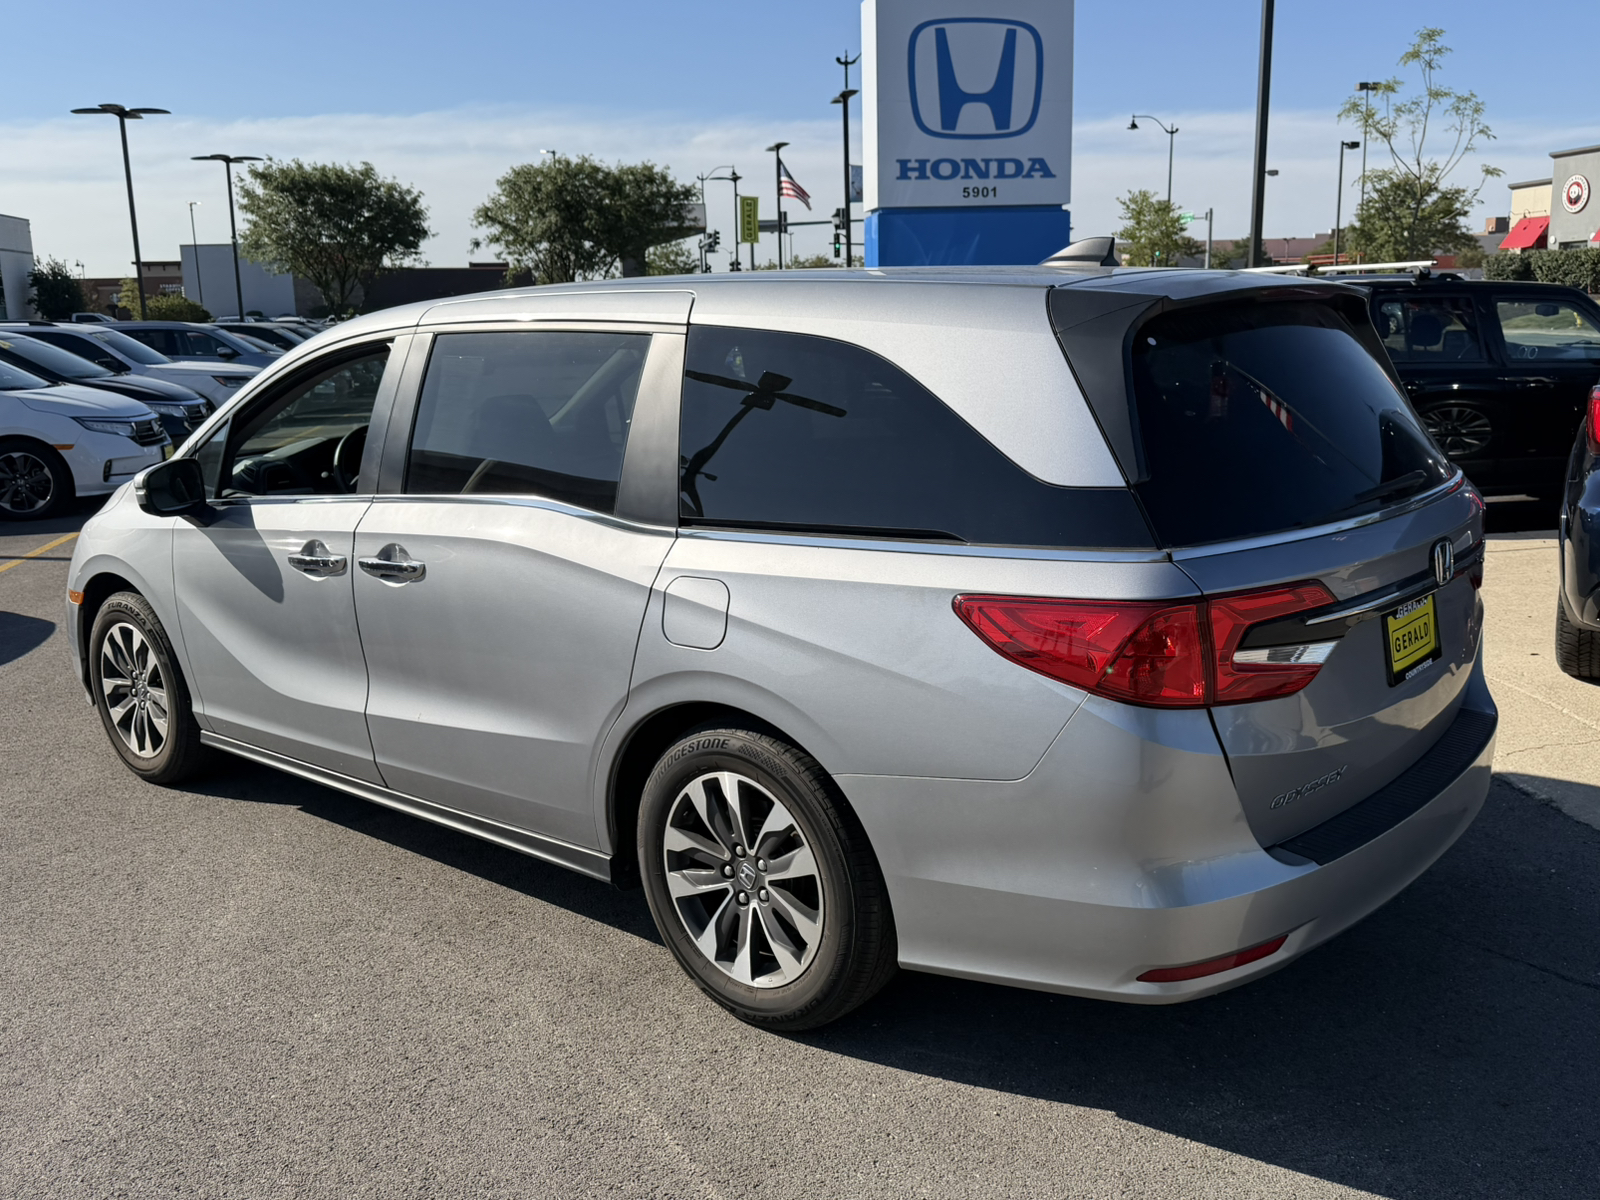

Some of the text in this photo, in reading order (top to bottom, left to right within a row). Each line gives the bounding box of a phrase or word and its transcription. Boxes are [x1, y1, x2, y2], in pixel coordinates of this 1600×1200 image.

[895, 157, 1057, 181] HONDA
[962, 186, 998, 199] 5901
[107, 601, 147, 627] TURANZA
[1394, 621, 1429, 653] GERALD
[1270, 764, 1348, 810] ODYSSEY
